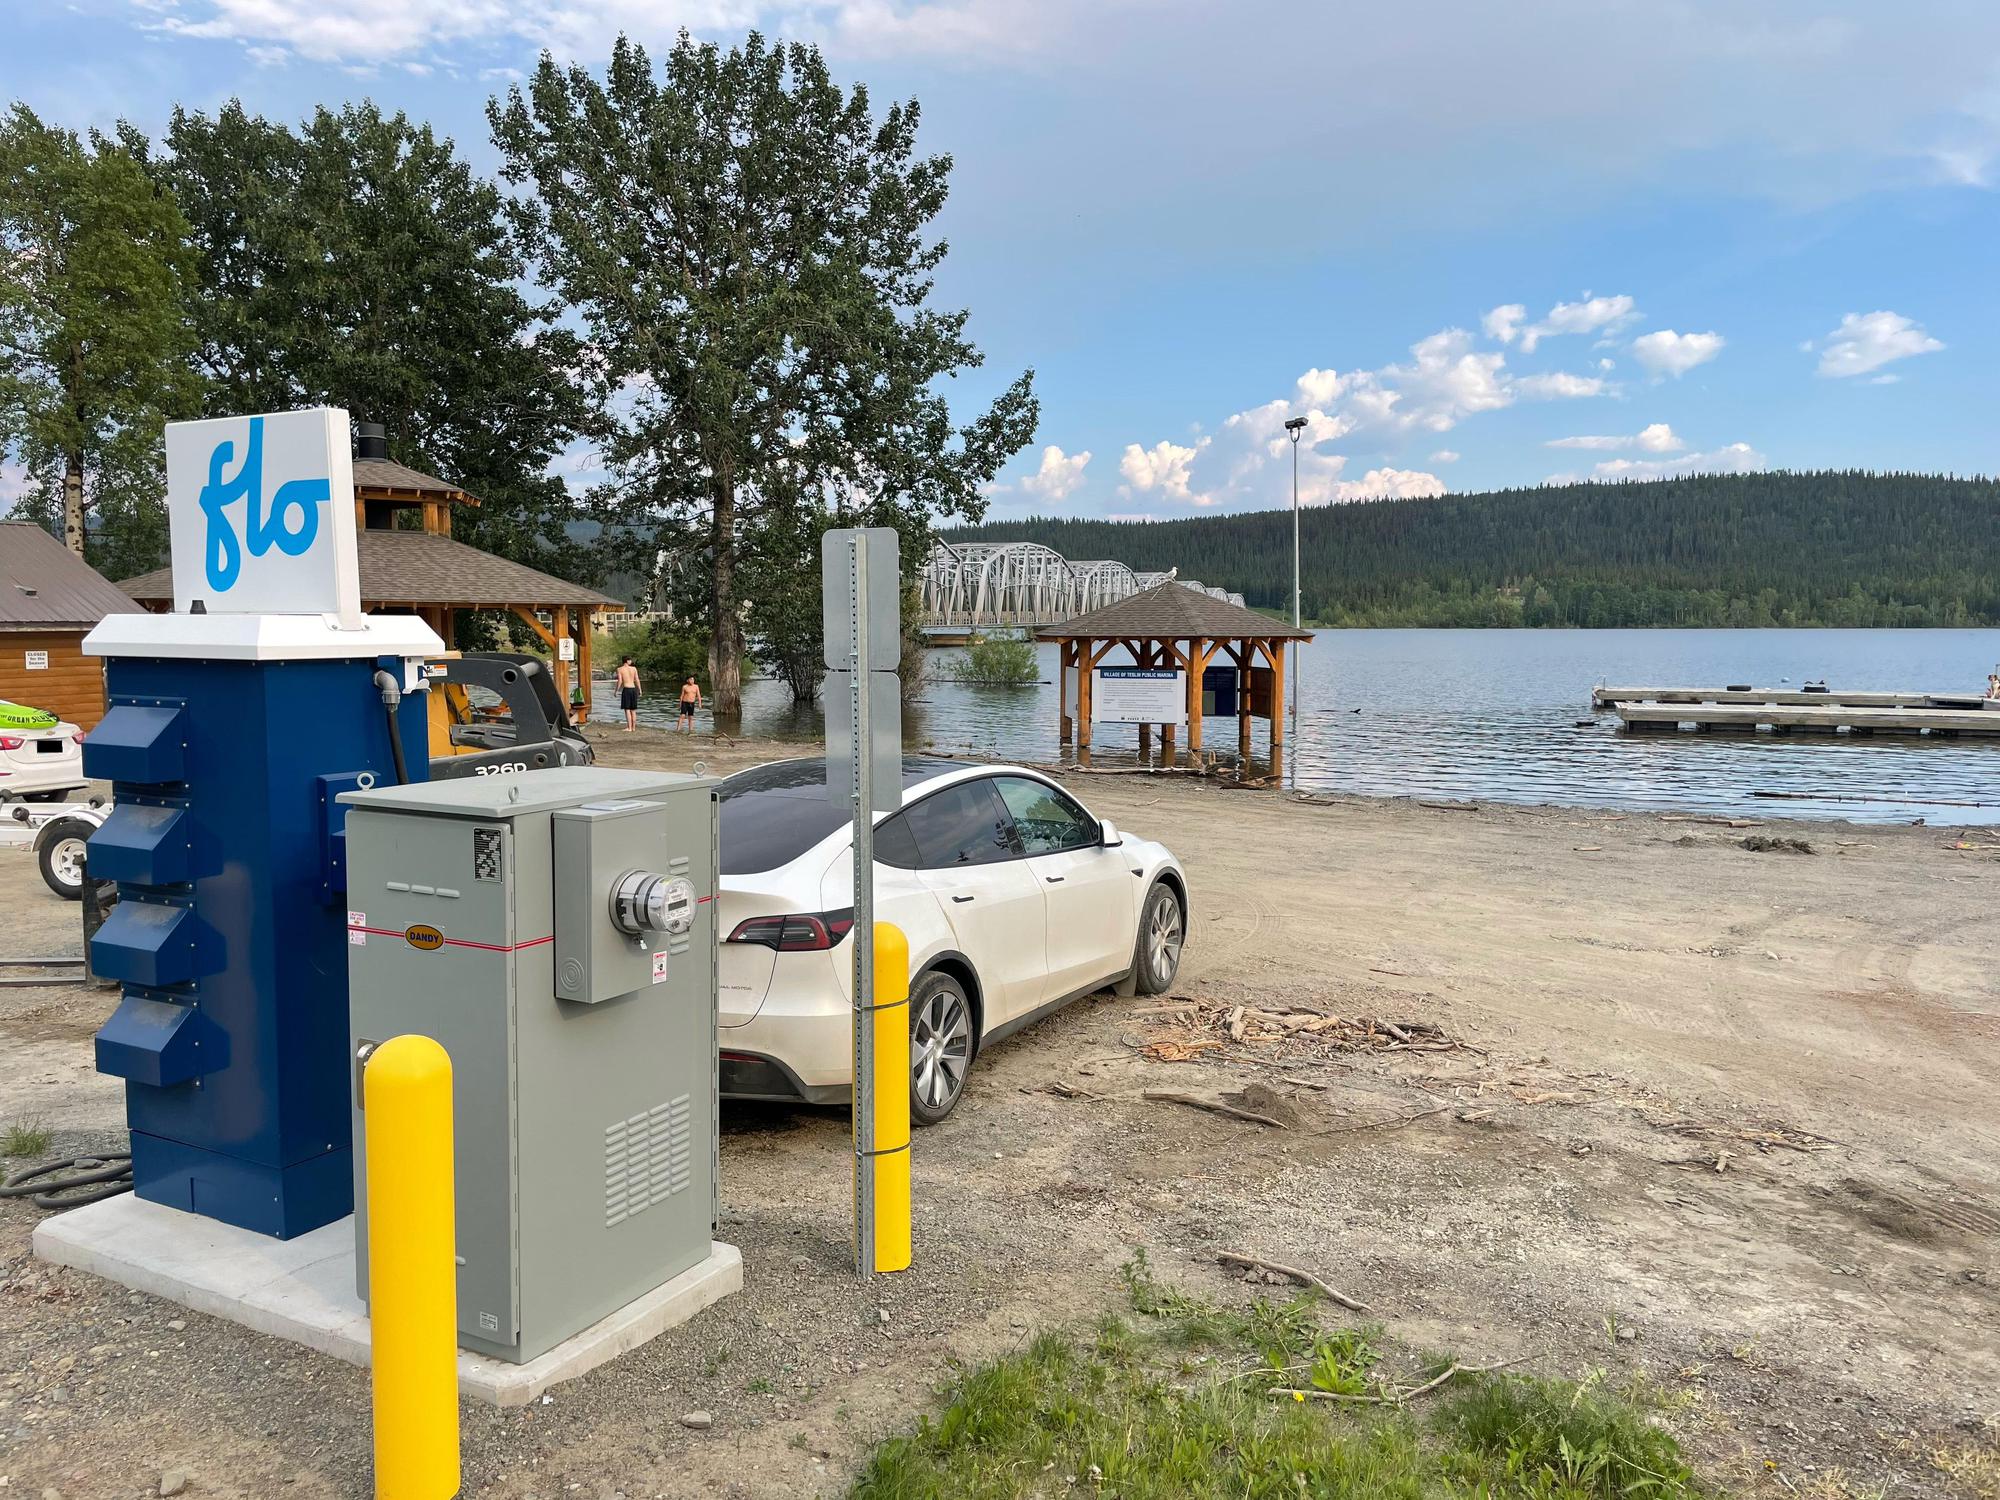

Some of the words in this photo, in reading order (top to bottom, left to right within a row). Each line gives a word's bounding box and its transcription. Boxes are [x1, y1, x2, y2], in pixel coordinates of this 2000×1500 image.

[199, 417, 330, 592] flo
[7, 715, 30, 723] URBAN
[475, 763, 527, 776] 326D
[410, 931, 439, 943] DANDY
